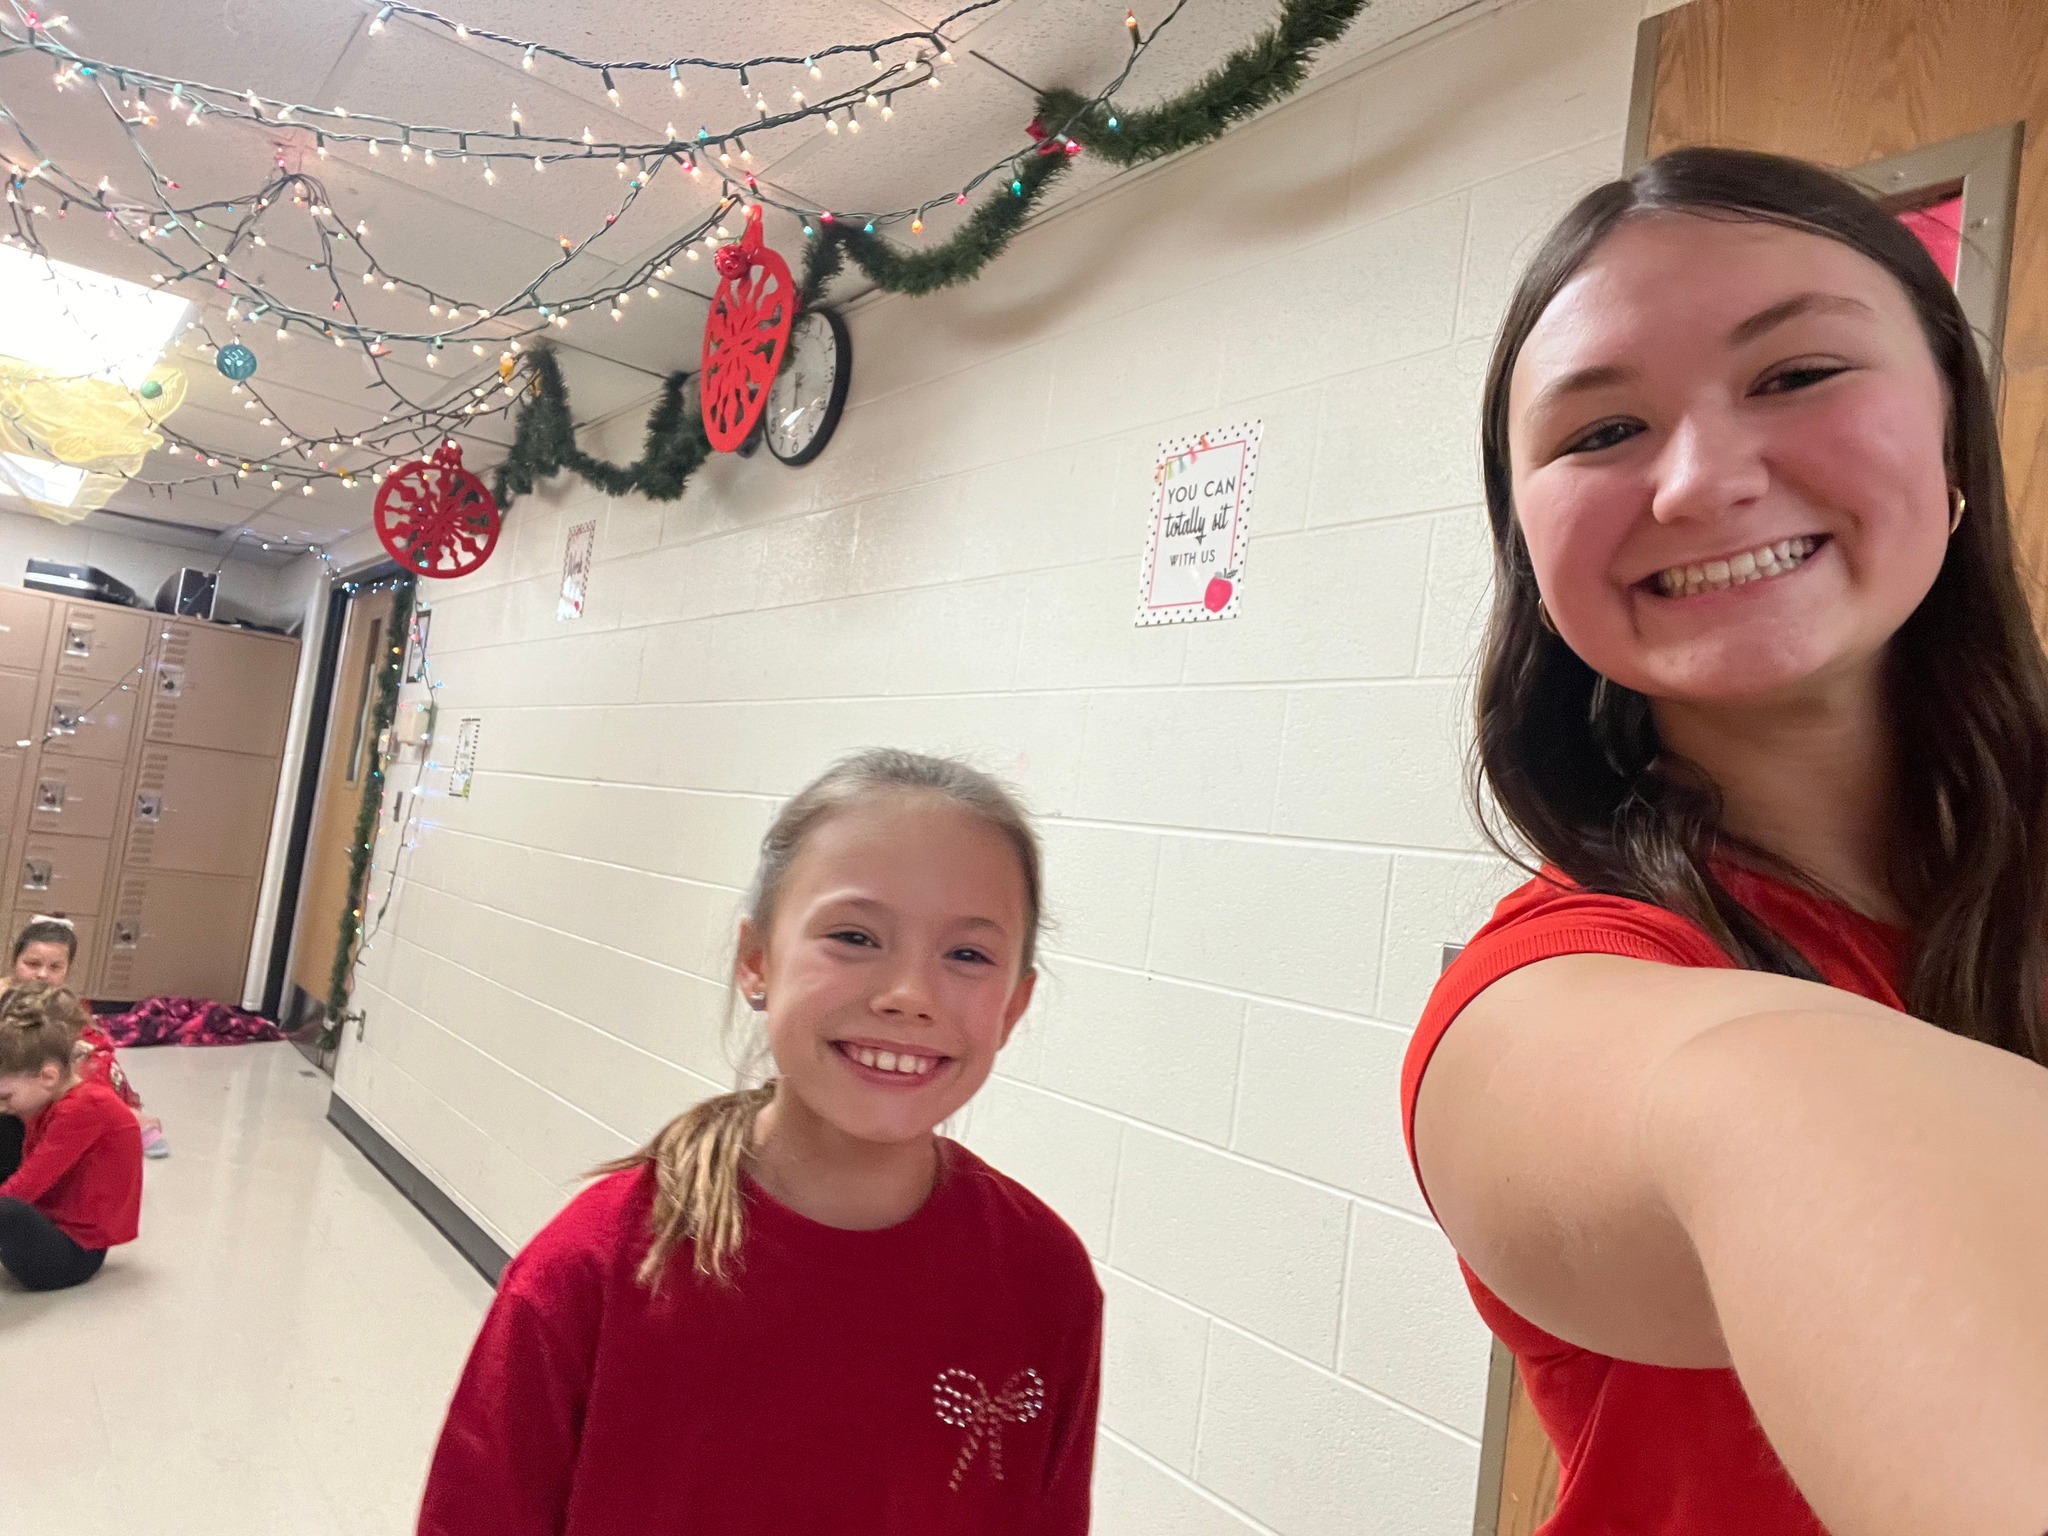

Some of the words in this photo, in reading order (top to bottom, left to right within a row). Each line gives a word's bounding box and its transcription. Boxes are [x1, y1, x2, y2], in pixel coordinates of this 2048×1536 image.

[1168, 484, 1197, 504] YOU
[1204, 476, 1235, 497] CAN
[1163, 506, 1206, 545] totally
[1212, 504, 1233, 530] sit
[1170, 552, 1196, 566] WITH
[1201, 549, 1215, 563] US
